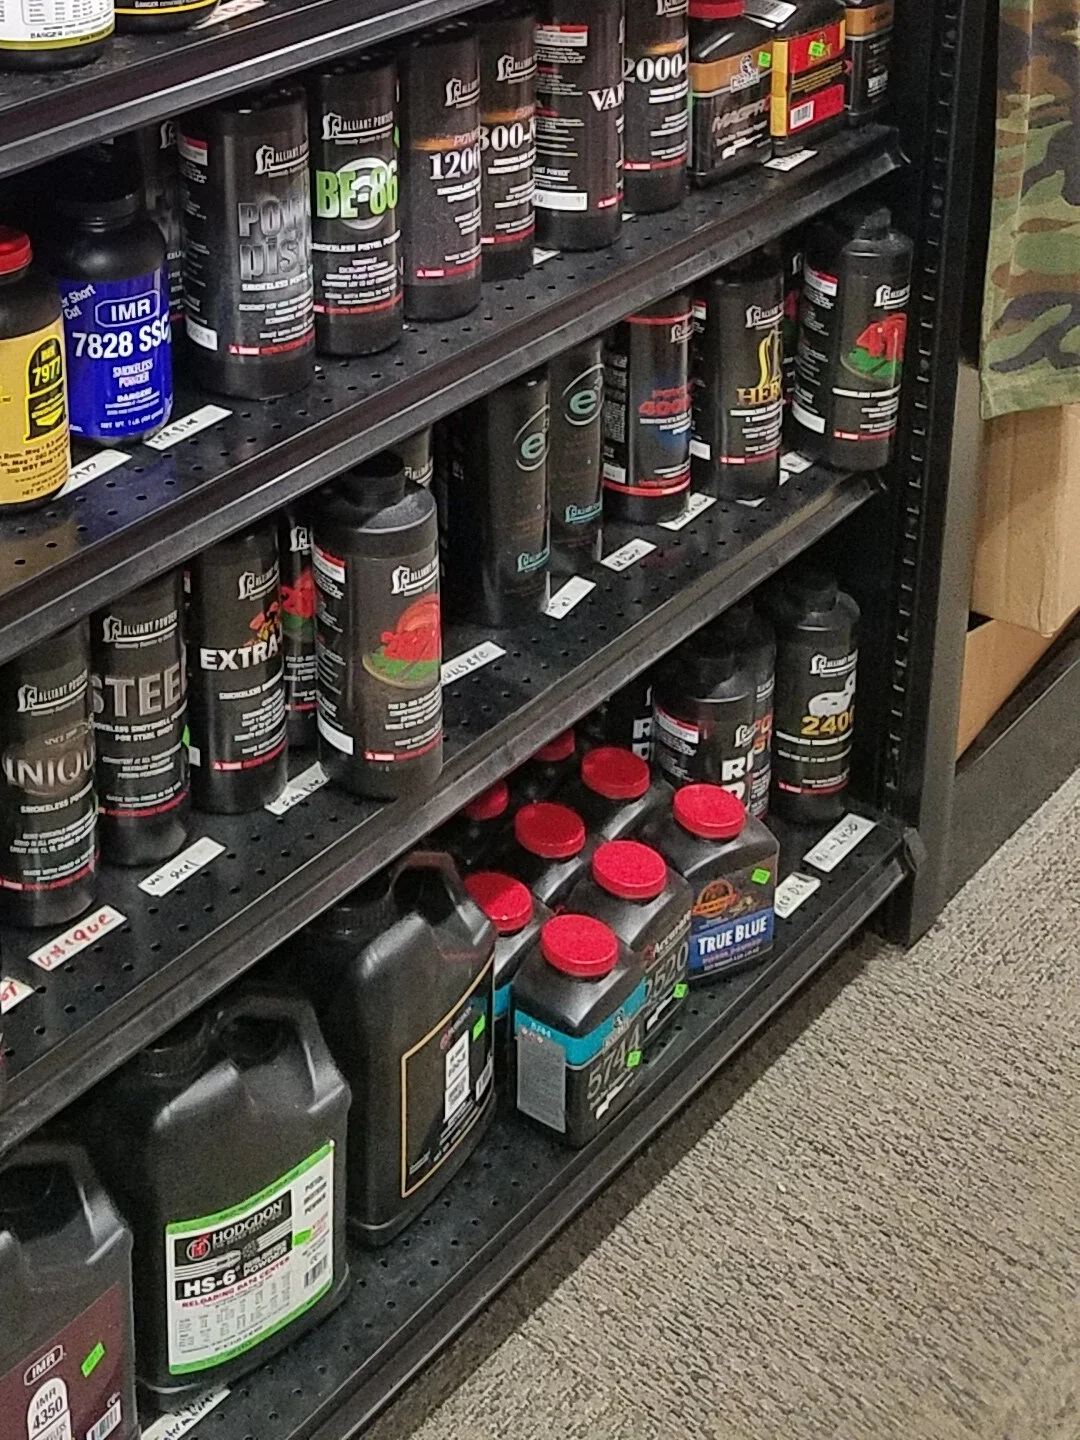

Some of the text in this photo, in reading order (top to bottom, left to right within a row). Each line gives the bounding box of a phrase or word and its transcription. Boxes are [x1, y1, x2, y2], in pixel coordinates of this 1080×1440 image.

[30, 30, 63, 39] DANGER
[316, 159, 398, 220] BE-86
[111, 298, 151, 322] IMR
[72, 331, 133, 359] 7828
[32, 355, 62, 387] 7977
[698, 916, 768, 956] TRUE BLUE
[211, 1199, 284, 1247] HODGDON
[181, 1256, 291, 1309] RELOADING CENTER
[183, 1269, 238, 1298] HS-6
[31, 1351, 58, 1380] IMR
[35, 1384, 58, 1410] IMR
[31, 1394, 65, 1432] 4350
